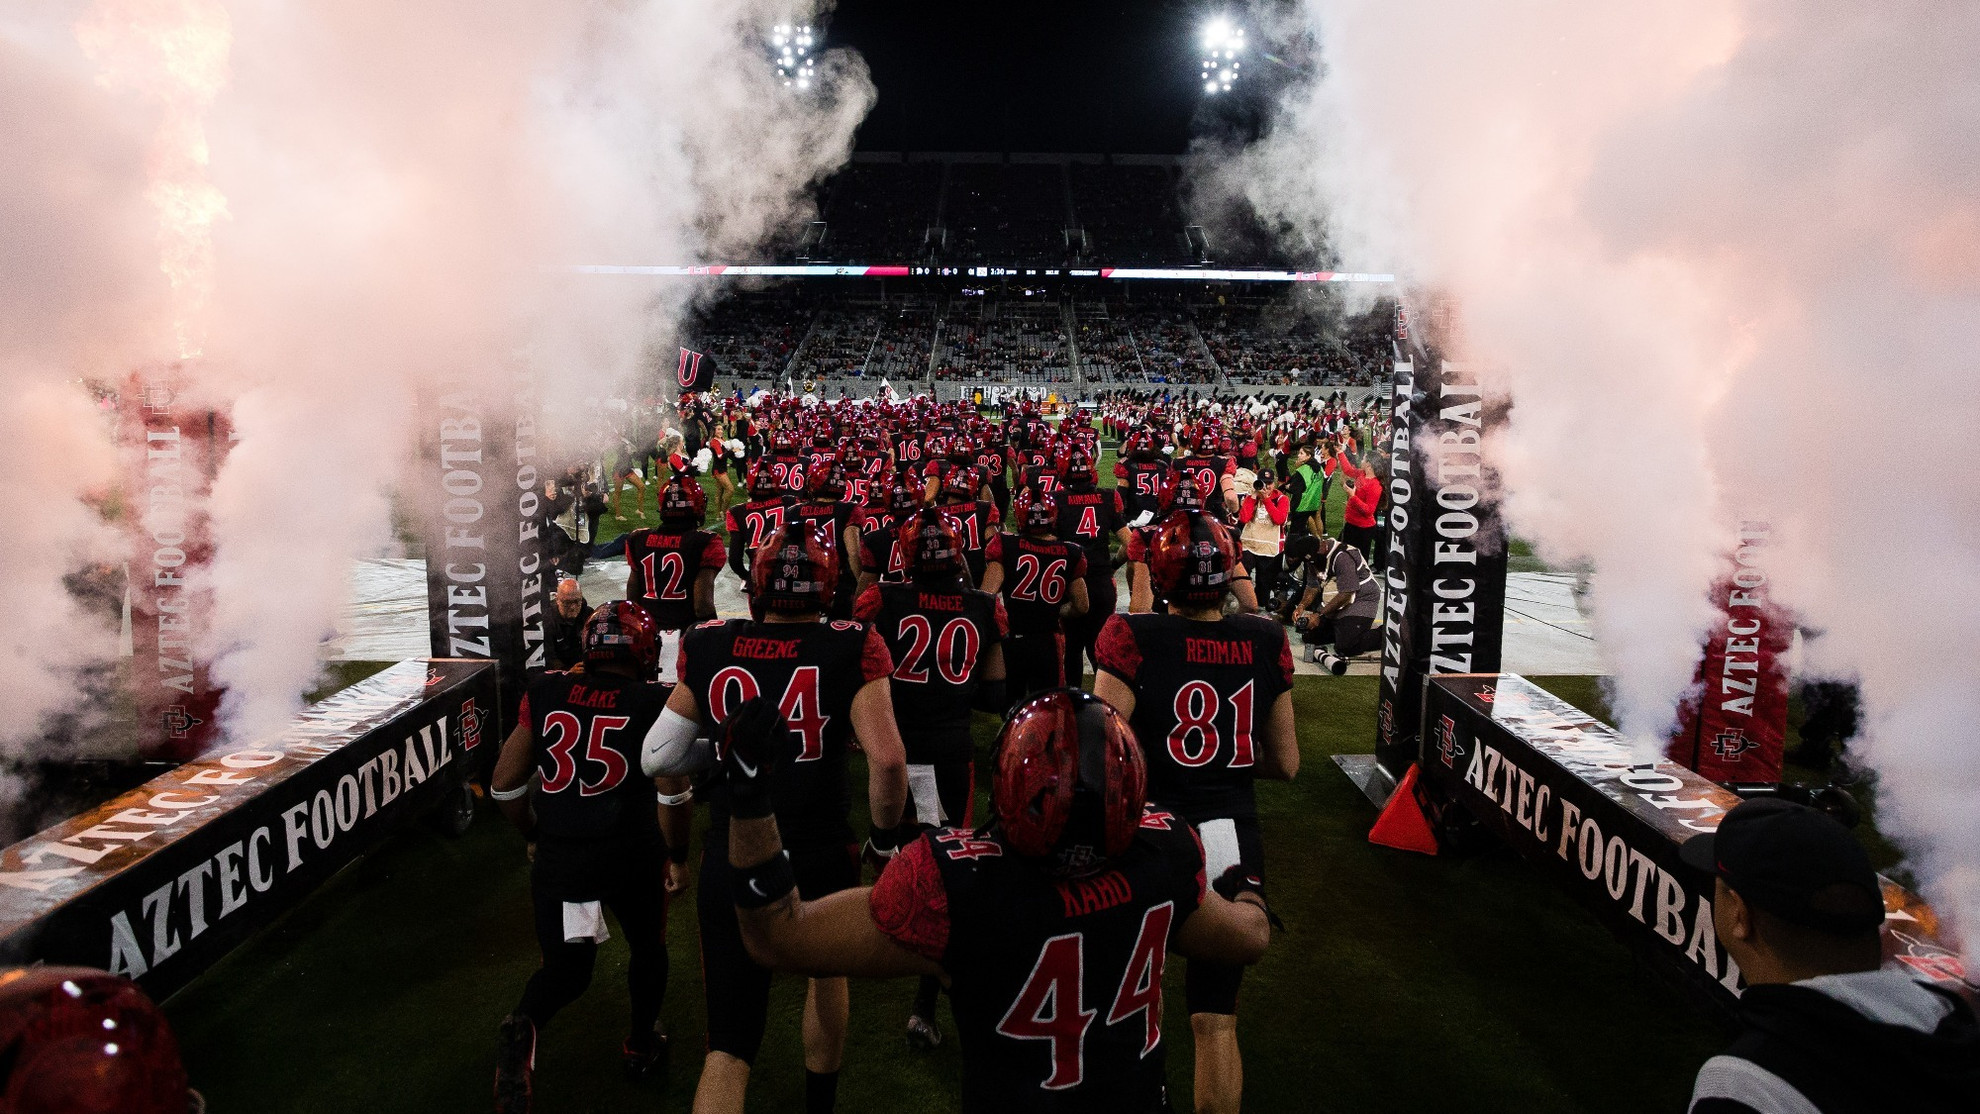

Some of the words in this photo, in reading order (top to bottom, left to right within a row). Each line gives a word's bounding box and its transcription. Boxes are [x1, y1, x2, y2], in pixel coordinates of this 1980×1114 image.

[678, 346, 703, 387] U
[439, 391, 486, 550] FOOTBA
[515, 413, 540, 545] FOOTB
[899, 439, 921, 461] 16
[1136, 472, 1160, 496] 51
[1389, 353, 1415, 558] FOOTBALL
[146, 425, 188, 588] FOOBALL
[645, 534, 682, 549] BRANCH
[745, 506, 785, 550] 27
[1076, 506, 1100, 539] 4
[640, 551, 687, 599] 12
[782, 564, 799, 578] 94
[918, 592, 964, 612] MAGEE
[1010, 553, 1067, 604] 26
[1728, 521, 1771, 608] FOOT
[155, 597, 195, 695] AZTEC
[445, 561, 492, 658] ZTEC
[520, 551, 547, 670] AZTEC
[732, 636, 802, 659] GREENE
[893, 614, 980, 685] 20
[1185, 637, 1253, 665] REDMAN
[1382, 569, 1409, 694] AZTEC
[1430, 577, 1475, 675] ZTEC
[567, 684, 621, 709] BLAKE
[1721, 618, 1761, 717] AZTEC
[537, 710, 630, 797] 35
[1166, 677, 1254, 768] 81
[109, 826, 271, 981] AZTEC
[280, 715, 453, 874] FOOTBALL
[1464, 736, 1551, 843] AZTEC
[1557, 797, 1748, 1000] FOOTBA
[996, 900, 1174, 1090] 44
